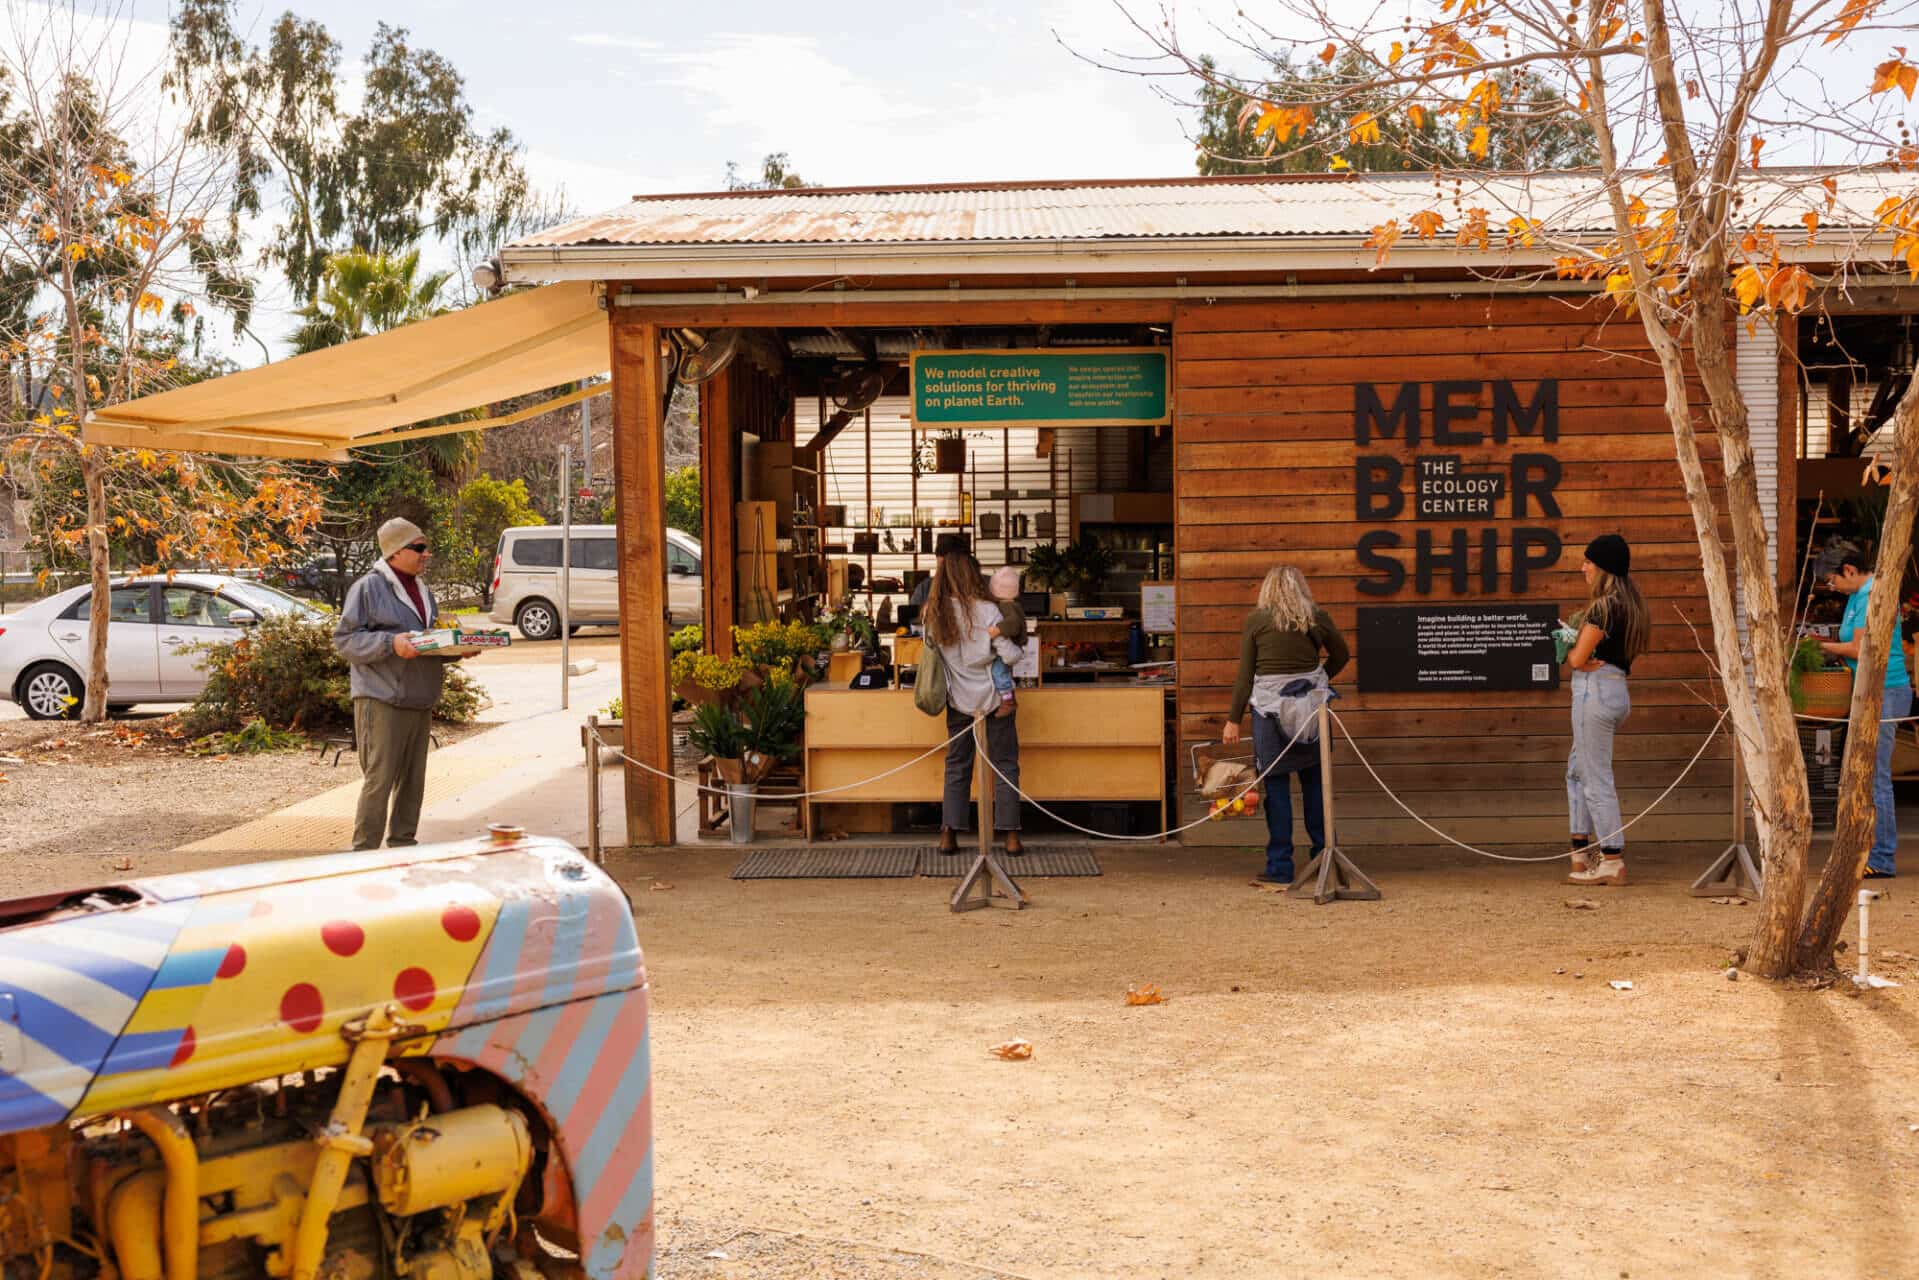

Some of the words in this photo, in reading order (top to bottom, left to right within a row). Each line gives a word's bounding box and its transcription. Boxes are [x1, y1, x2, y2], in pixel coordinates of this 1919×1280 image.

[924, 368, 944, 378] We
[948, 368, 986, 378] model
[990, 367, 1040, 378] creative
[925, 382, 982, 393] solutions
[986, 382, 1004, 392] for
[1008, 381, 1056, 394] thriving
[925, 398, 940, 407] on
[944, 396, 983, 410] planet
[987, 396, 1024, 406] Earth.
[1355, 379, 1558, 447] MEM
[1422, 461, 1455, 475] THE
[1422, 480, 1498, 494] ECOLOGY
[1422, 498, 1488, 512] CENTER
[1355, 527, 1562, 597] SHIP
